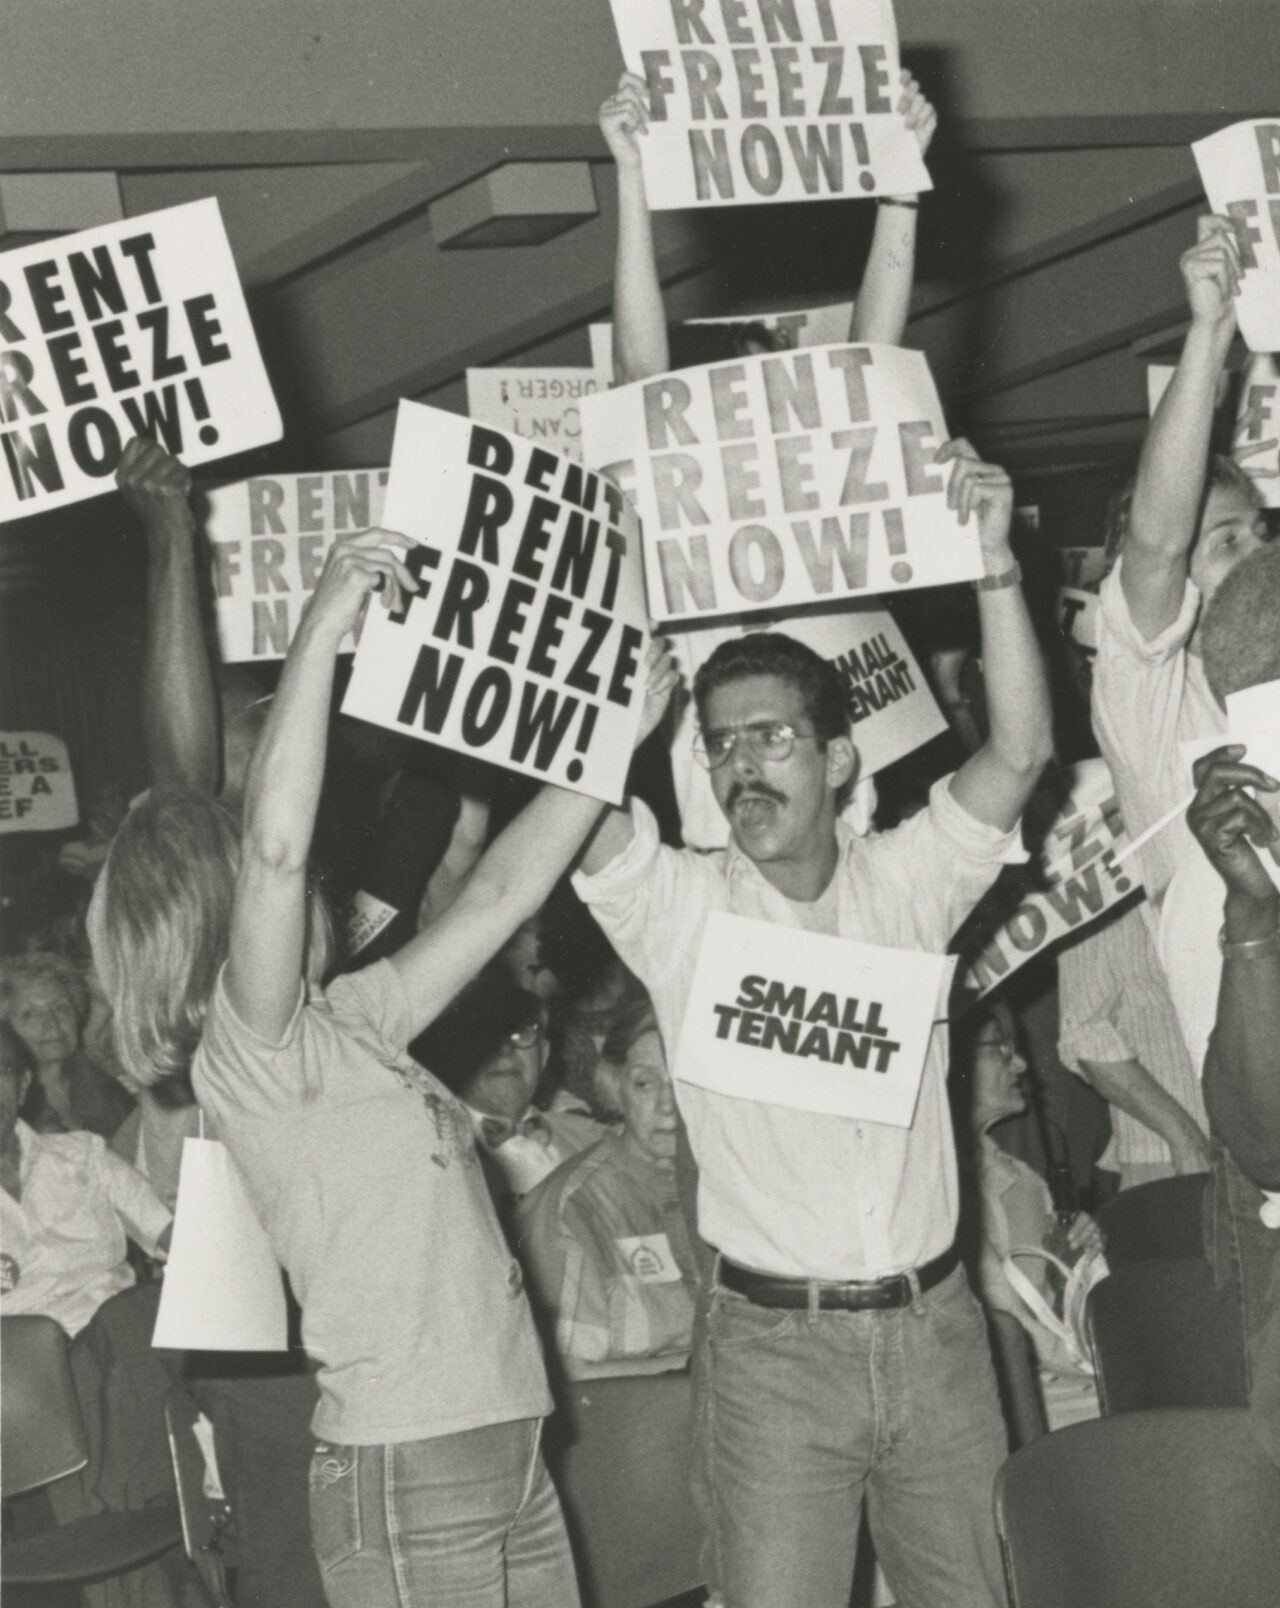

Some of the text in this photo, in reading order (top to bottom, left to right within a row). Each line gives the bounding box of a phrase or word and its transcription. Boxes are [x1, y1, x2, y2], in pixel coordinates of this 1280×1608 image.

[640, 44, 892, 122] FREEZE
[688, 122, 876, 201] NOW!
[0, 293, 231, 424] REEZE
[642, 347, 874, 450] RENT
[0, 377, 219, 501] NOW!
[247, 471, 389, 536] REN
[458, 473, 628, 612] RENT
[656, 508, 914, 615] NOW!
[387, 544, 644, 708] FREEZE
[834, 632, 899, 683] MALL
[397, 643, 601, 784] NOW!
[847, 660, 917, 724] ENANT
[0, 742, 40, 758] LL
[0, 757, 60, 775] ERS
[31, 774, 53, 795] A
[970, 848, 1132, 992] NOW!
[713, 1003, 902, 1074] TENANT
[735, 974, 888, 1038] SMALL
